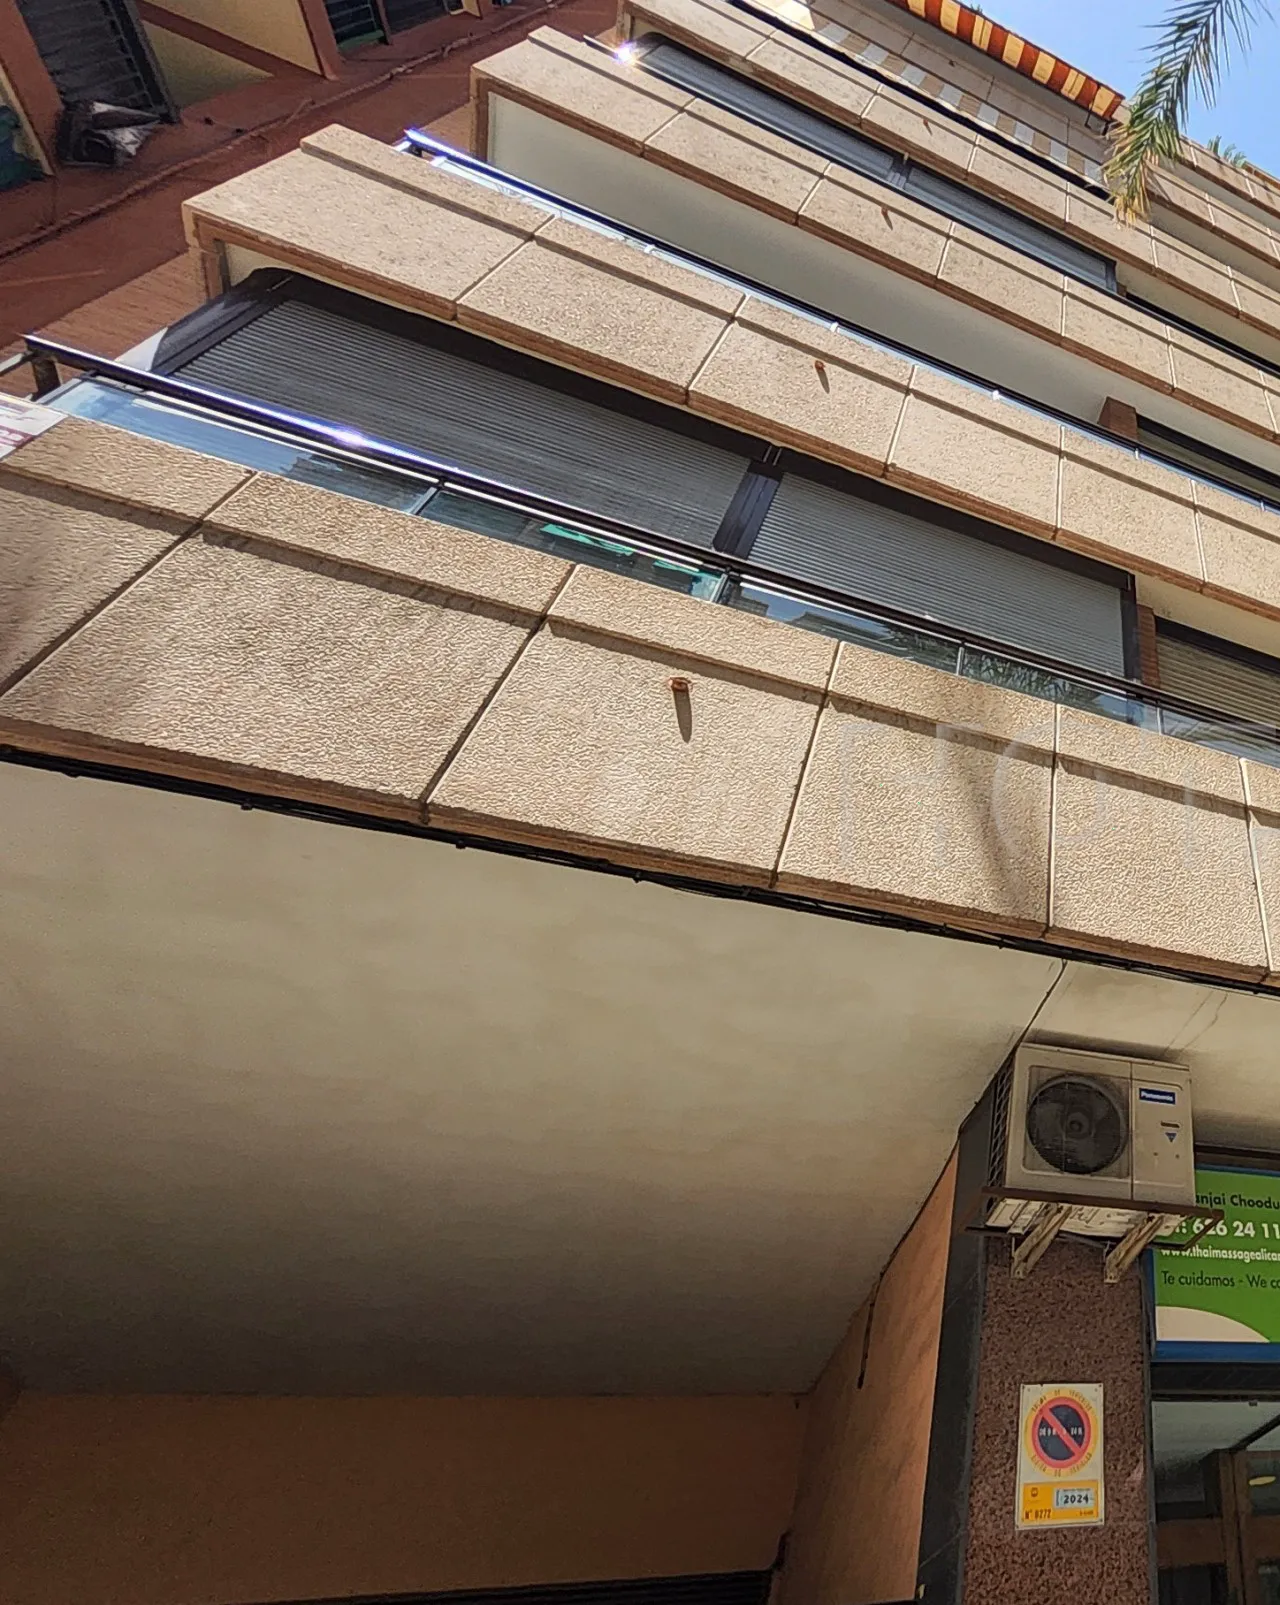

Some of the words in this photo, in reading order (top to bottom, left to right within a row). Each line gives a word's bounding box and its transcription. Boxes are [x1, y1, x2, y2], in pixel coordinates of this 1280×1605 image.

[1232, 1222, 1256, 1238] 24
[1262, 1223, 1280, 1240] 11
[1161, 1271, 1175, 1285] Te
[1178, 1271, 1235, 1287] cuidamos
[1246, 1273, 1267, 1288] We
[1064, 1494, 1089, 1504] 2024
